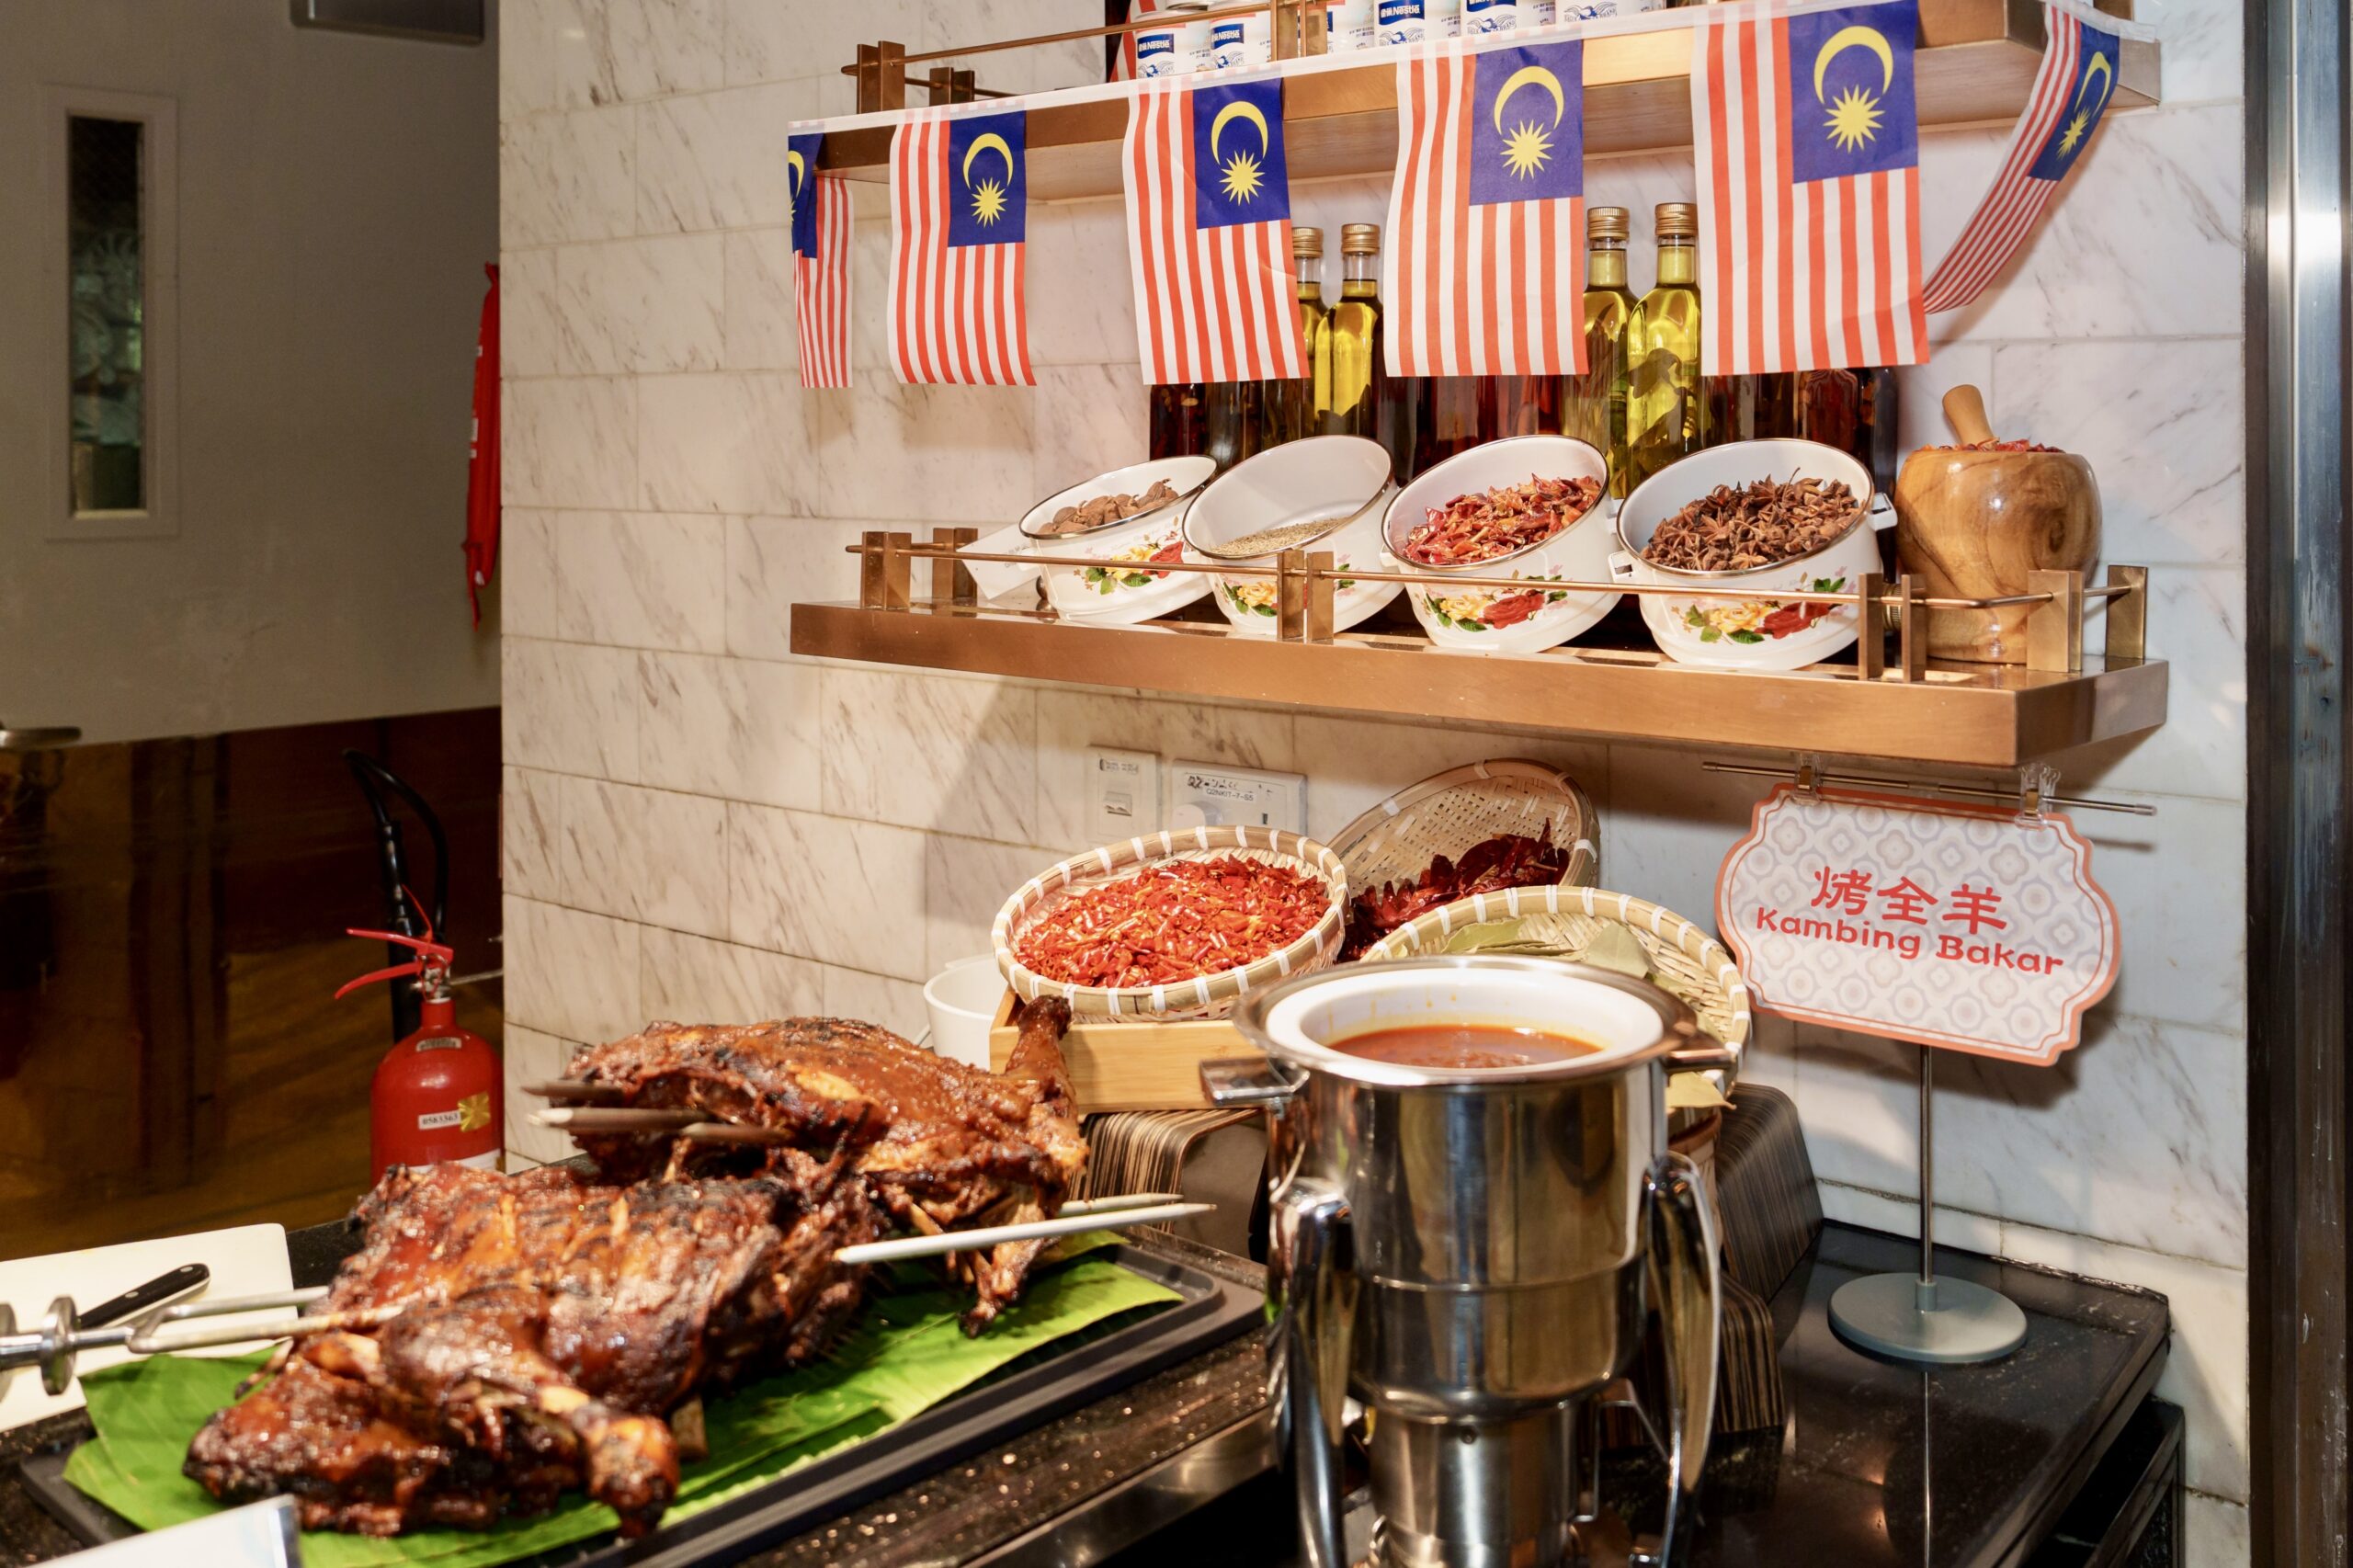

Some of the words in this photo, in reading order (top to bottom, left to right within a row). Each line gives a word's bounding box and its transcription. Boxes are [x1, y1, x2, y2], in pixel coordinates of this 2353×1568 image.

[1810, 866, 2006, 935] 烤全羊
[1756, 906, 1921, 960] Kambing
[1936, 934, 2063, 975] Bakar
